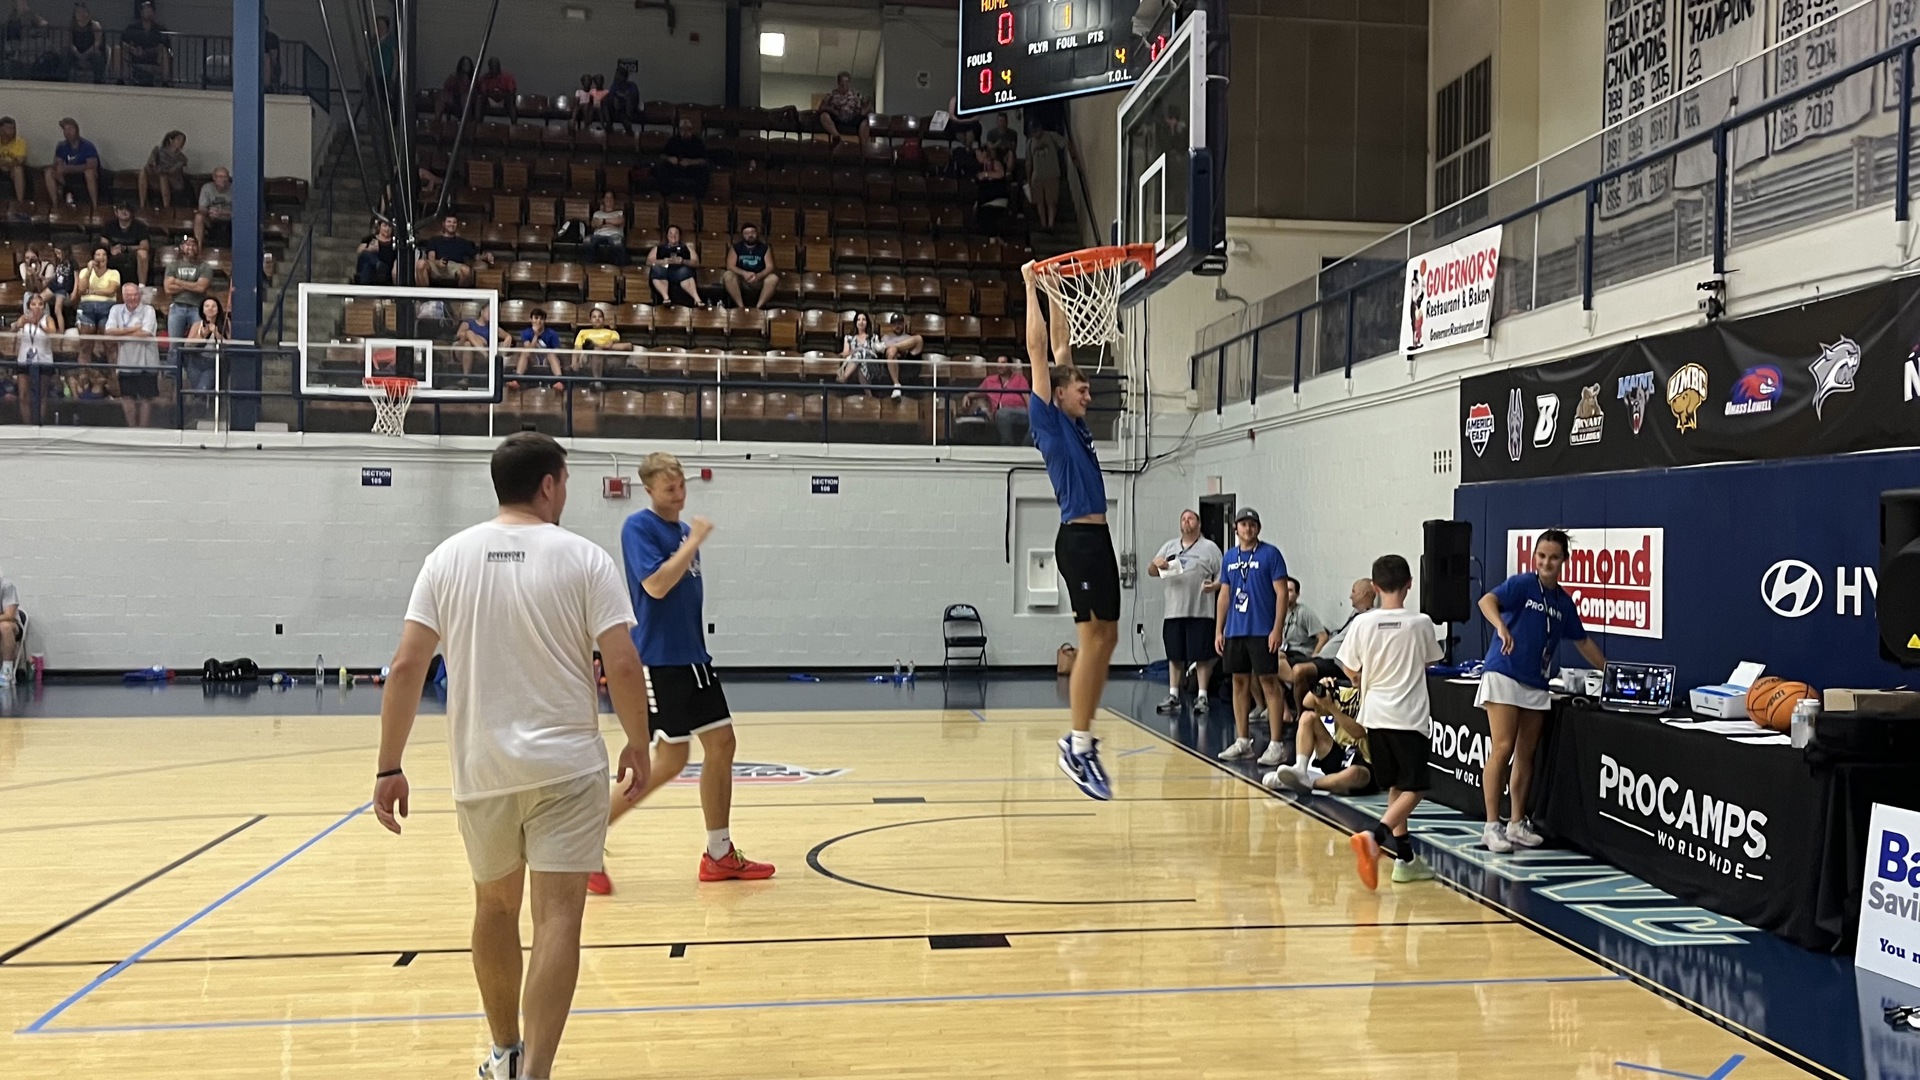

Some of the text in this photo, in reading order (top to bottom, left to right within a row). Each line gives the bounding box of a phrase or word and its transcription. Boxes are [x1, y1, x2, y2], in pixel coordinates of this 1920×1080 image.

[997, 12, 1014, 45] 0
[1028, 30, 1104, 55] PLYR FOUL PTS
[1115, 48, 1126, 63] 4
[966, 51, 993, 68] FOULS
[980, 68, 1012, 93] 0 4
[1108, 69, 1132, 83] T.O.L.
[994, 89, 1017, 103] T.O.L.
[1426, 248, 1497, 298] GOVERNOR'S
[1426, 294, 1460, 318] Restaurant
[1462, 291, 1467, 308] &
[1617, 371, 1656, 399] MAINE
[1668, 366, 1708, 401] UMBC
[1467, 417, 1493, 430] AMERICA
[1471, 429, 1488, 441] EAST
[362, 469, 391, 477] SECTION
[1517, 535, 1652, 587] Hmond
[1571, 589, 1646, 628] Company
[1600, 753, 1768, 858] PROCAMPS
[1657, 829, 1744, 880] WORLDWIDE
[1868, 880, 1920, 922] Savi
[1880, 937, 1906, 959] You
